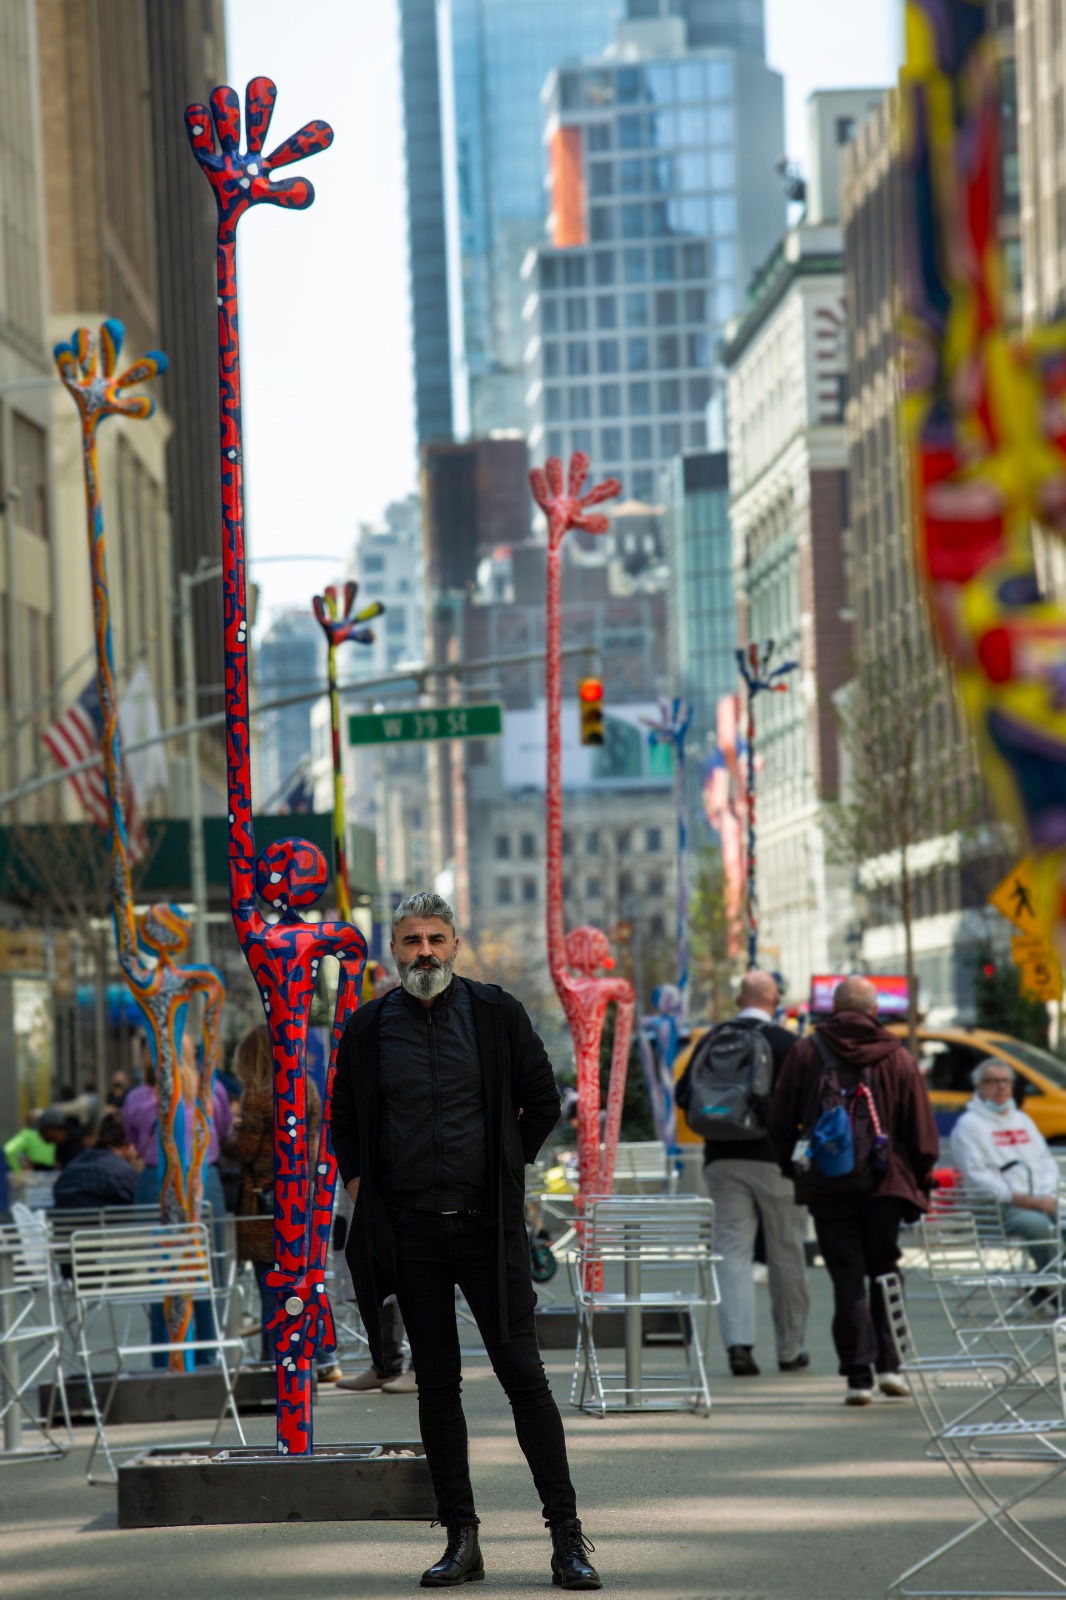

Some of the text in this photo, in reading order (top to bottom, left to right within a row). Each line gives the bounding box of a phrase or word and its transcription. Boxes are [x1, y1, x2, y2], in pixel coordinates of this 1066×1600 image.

[382, 711, 468, 738] W 39 St
